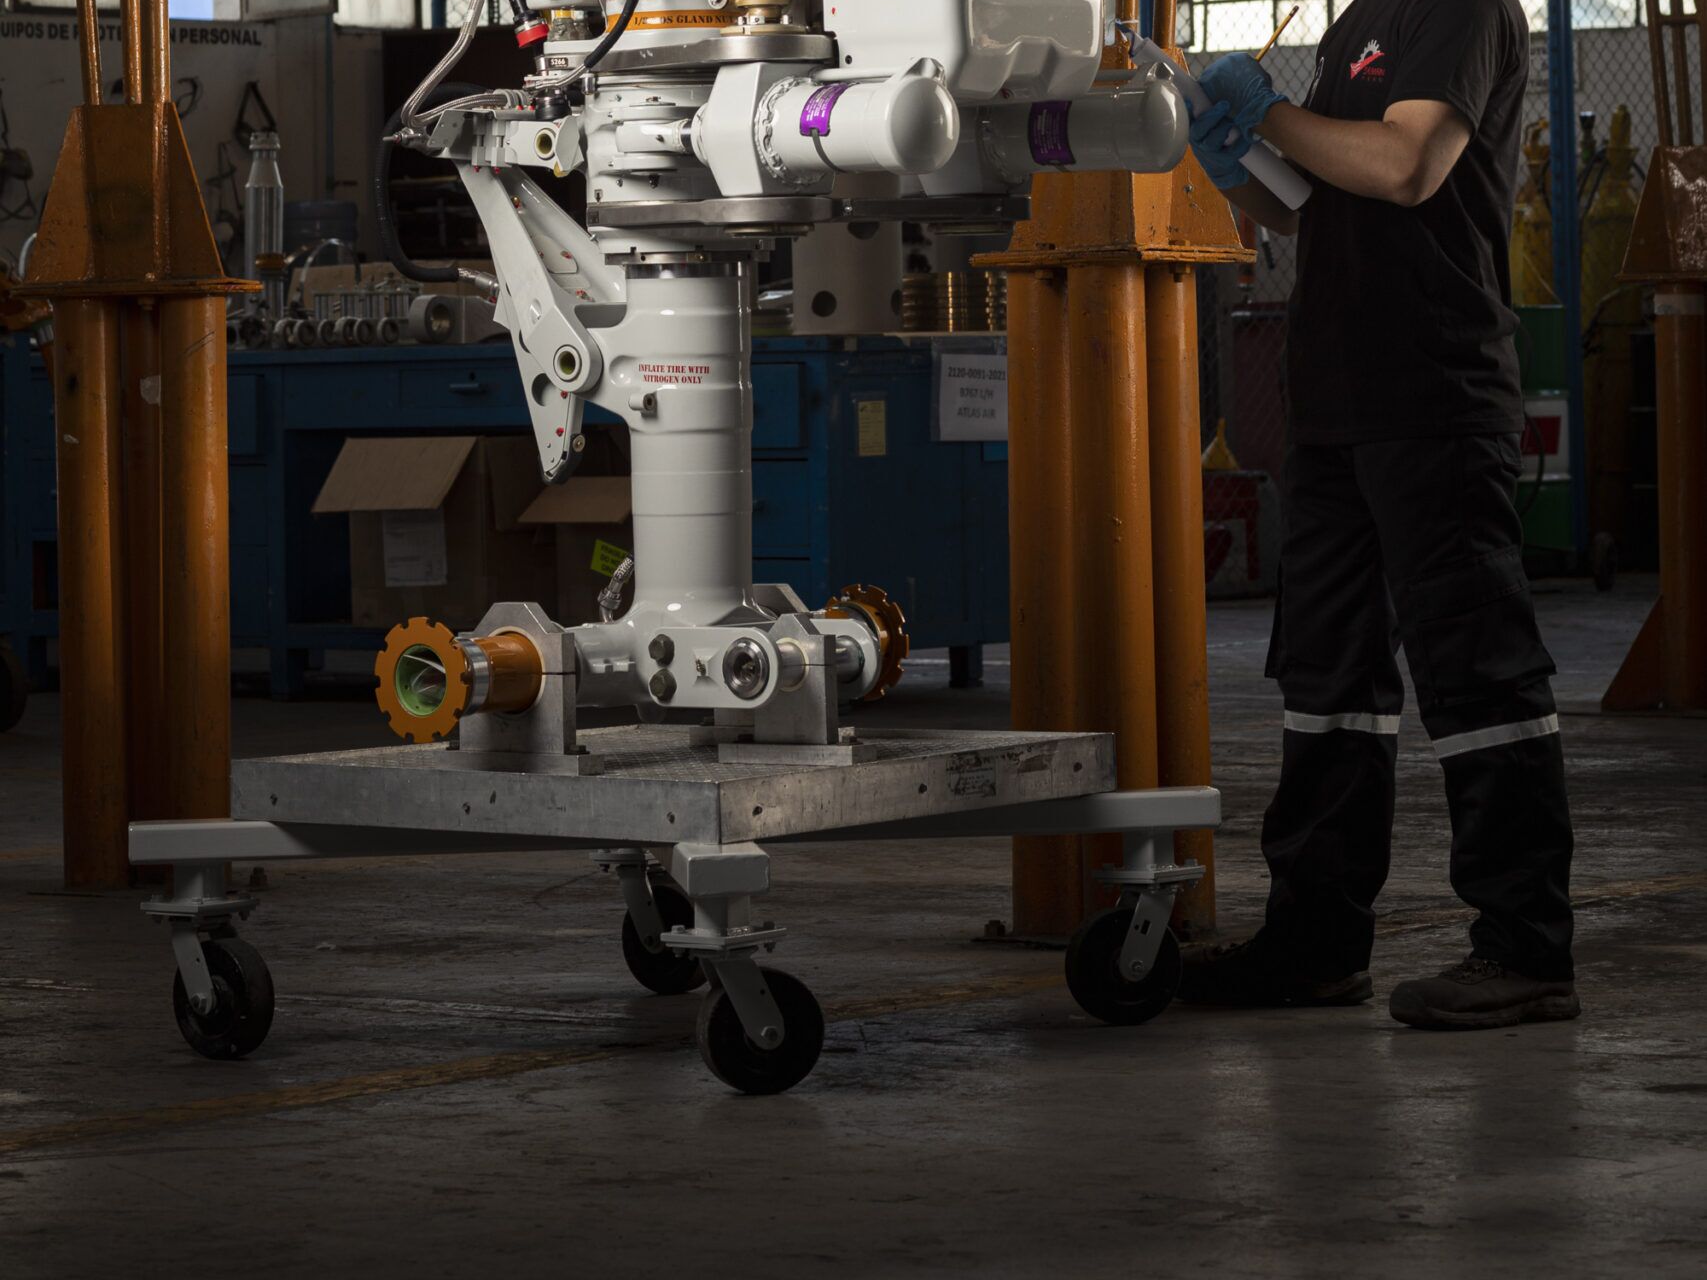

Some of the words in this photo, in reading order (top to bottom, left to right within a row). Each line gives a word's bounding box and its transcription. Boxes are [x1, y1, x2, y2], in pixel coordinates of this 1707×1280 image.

[676, 14, 713, 24] GLAND
[48, 24, 69, 39] DE
[180, 27, 262, 46] PERSONAL
[638, 364, 666, 373] INFLATE
[667, 365, 687, 373] TIRE
[688, 366, 710, 374] WITH
[643, 375, 680, 384] NITROGEN
[681, 376, 703, 384] ONLY
[957, 407, 981, 418] ATLAS
